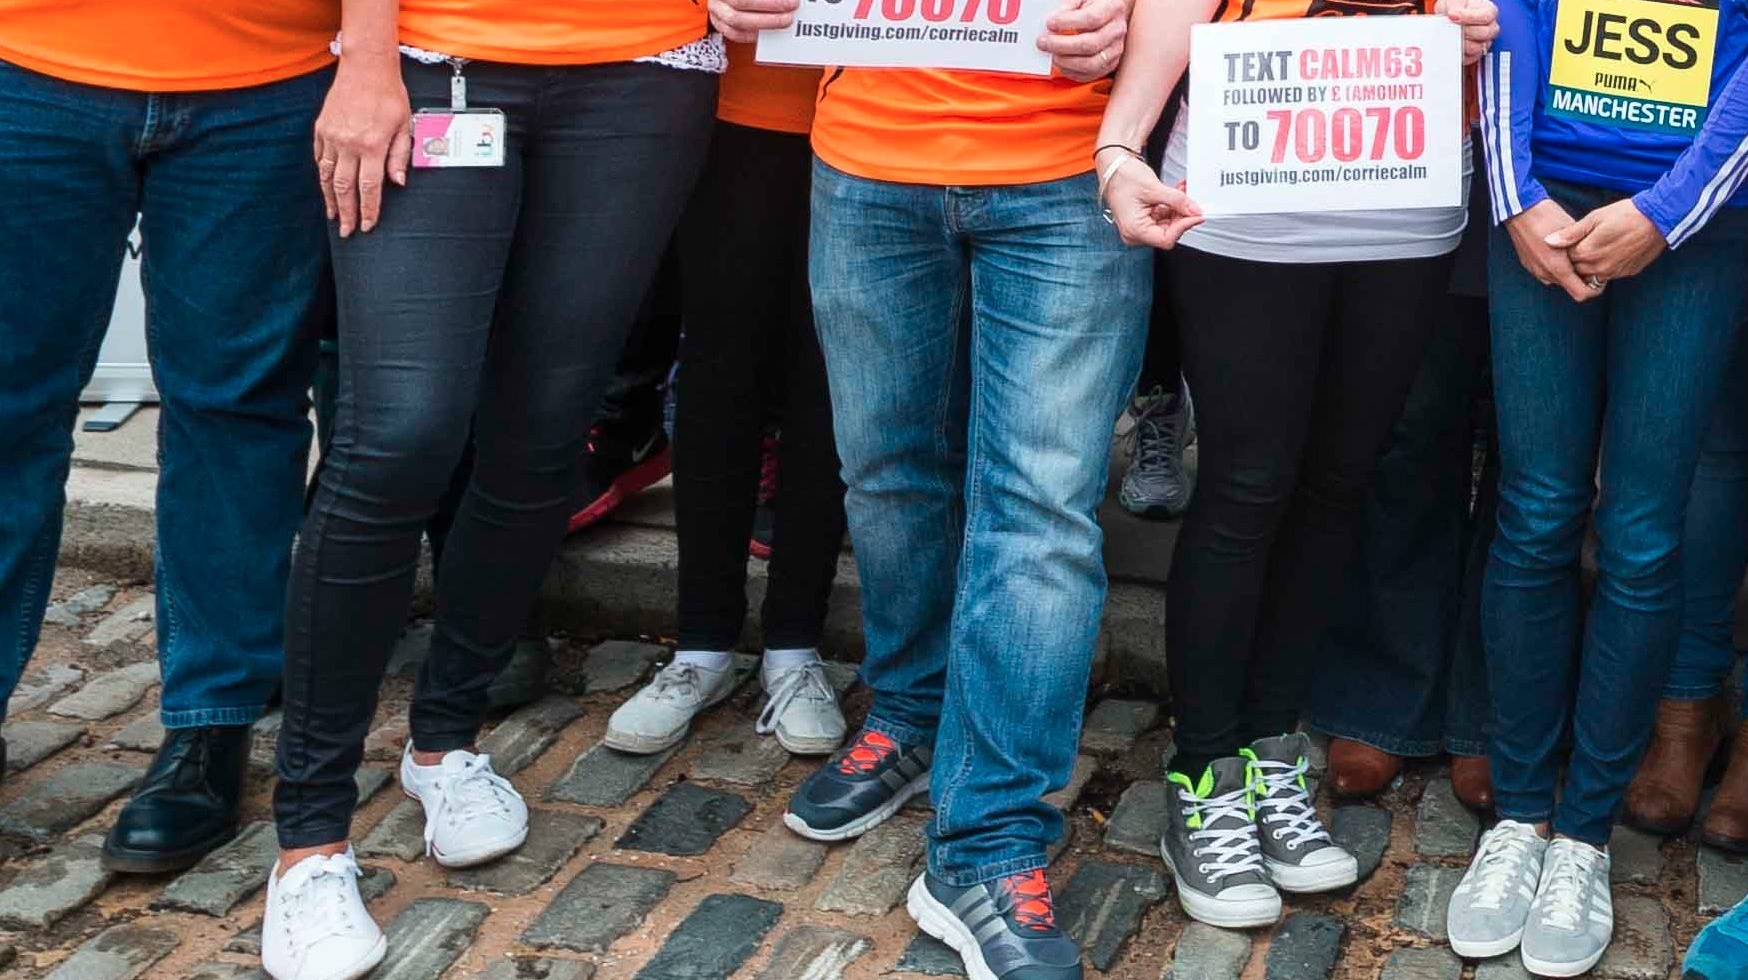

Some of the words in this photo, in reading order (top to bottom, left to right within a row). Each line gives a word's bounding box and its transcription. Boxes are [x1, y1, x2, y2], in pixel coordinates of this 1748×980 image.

[794, 20, 1019, 44] justgiving.com/corriecalm
[1564, 10, 1701, 70] JESS
[1223, 50, 1293, 84] TEXT
[1299, 45, 1424, 81] CALM63
[1223, 86, 1303, 106] FOLLOWED
[1307, 86, 1328, 103] BY
[1594, 72, 1637, 93] PUMA
[1552, 89, 1698, 130] MANCHESTER
[1223, 120, 1260, 151] TO
[1266, 105, 1425, 164] 70070
[1219, 163, 1427, 187] justgiving.com/corriecalm
